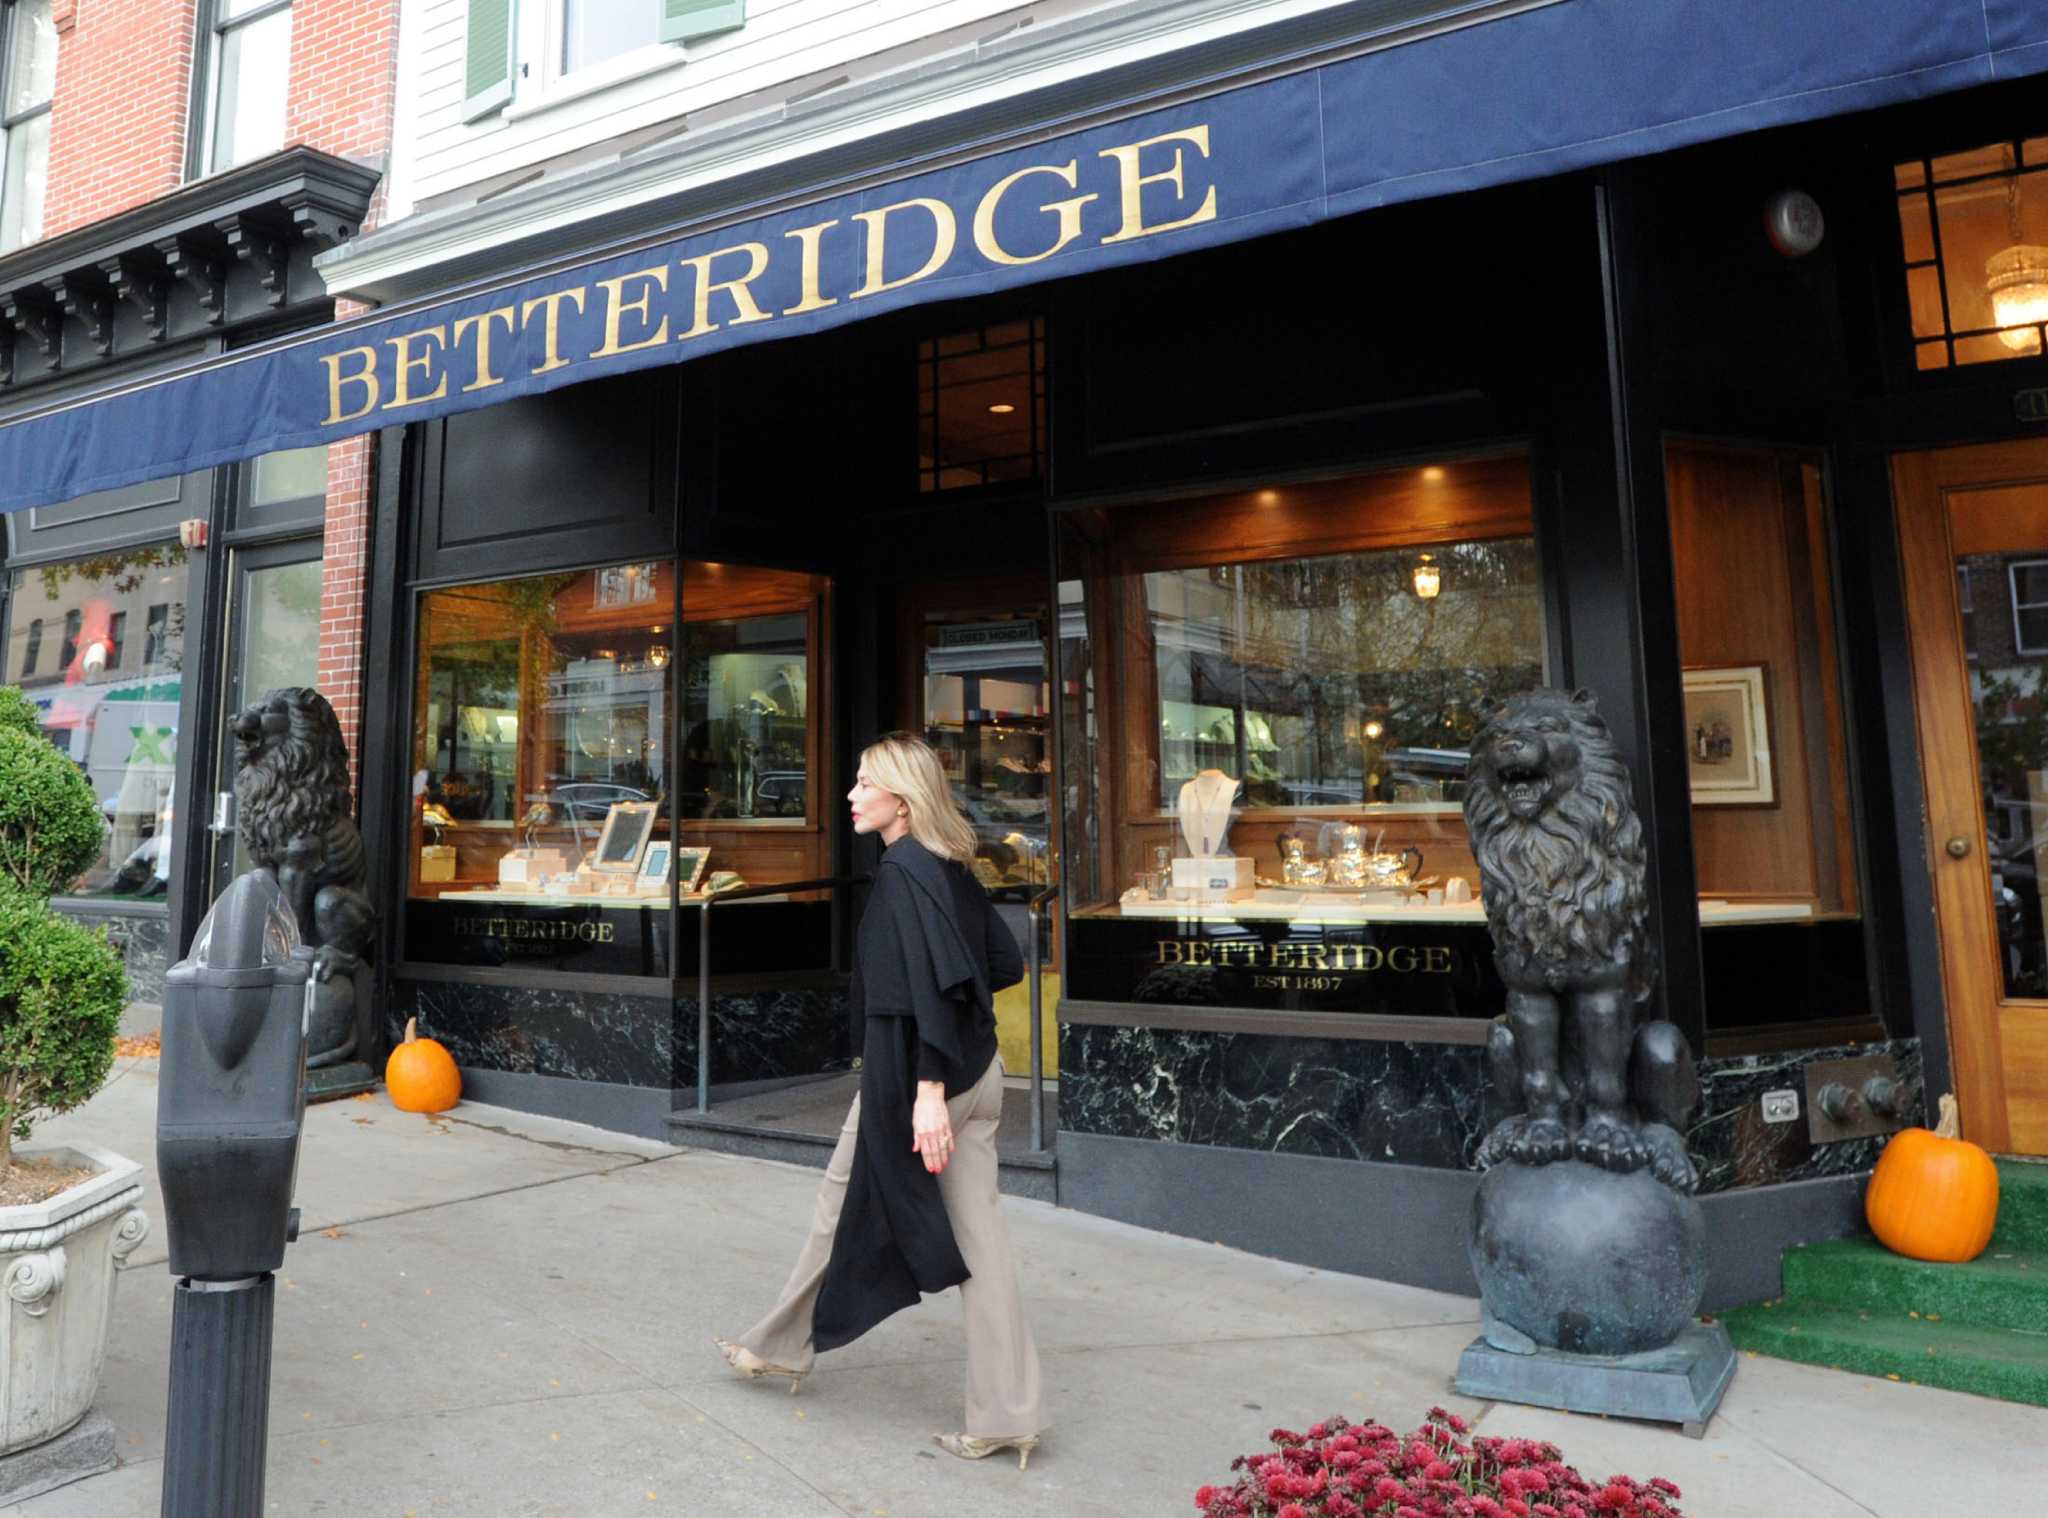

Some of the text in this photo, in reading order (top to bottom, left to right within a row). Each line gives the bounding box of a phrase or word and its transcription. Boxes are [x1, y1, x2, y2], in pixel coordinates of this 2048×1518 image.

[319, 123, 1219, 427] BETTERIDGE
[453, 917, 614, 943] BETTERIDGE
[1155, 940, 1452, 973] BETTERIDGE
[1253, 974, 1344, 991] EST 1897
